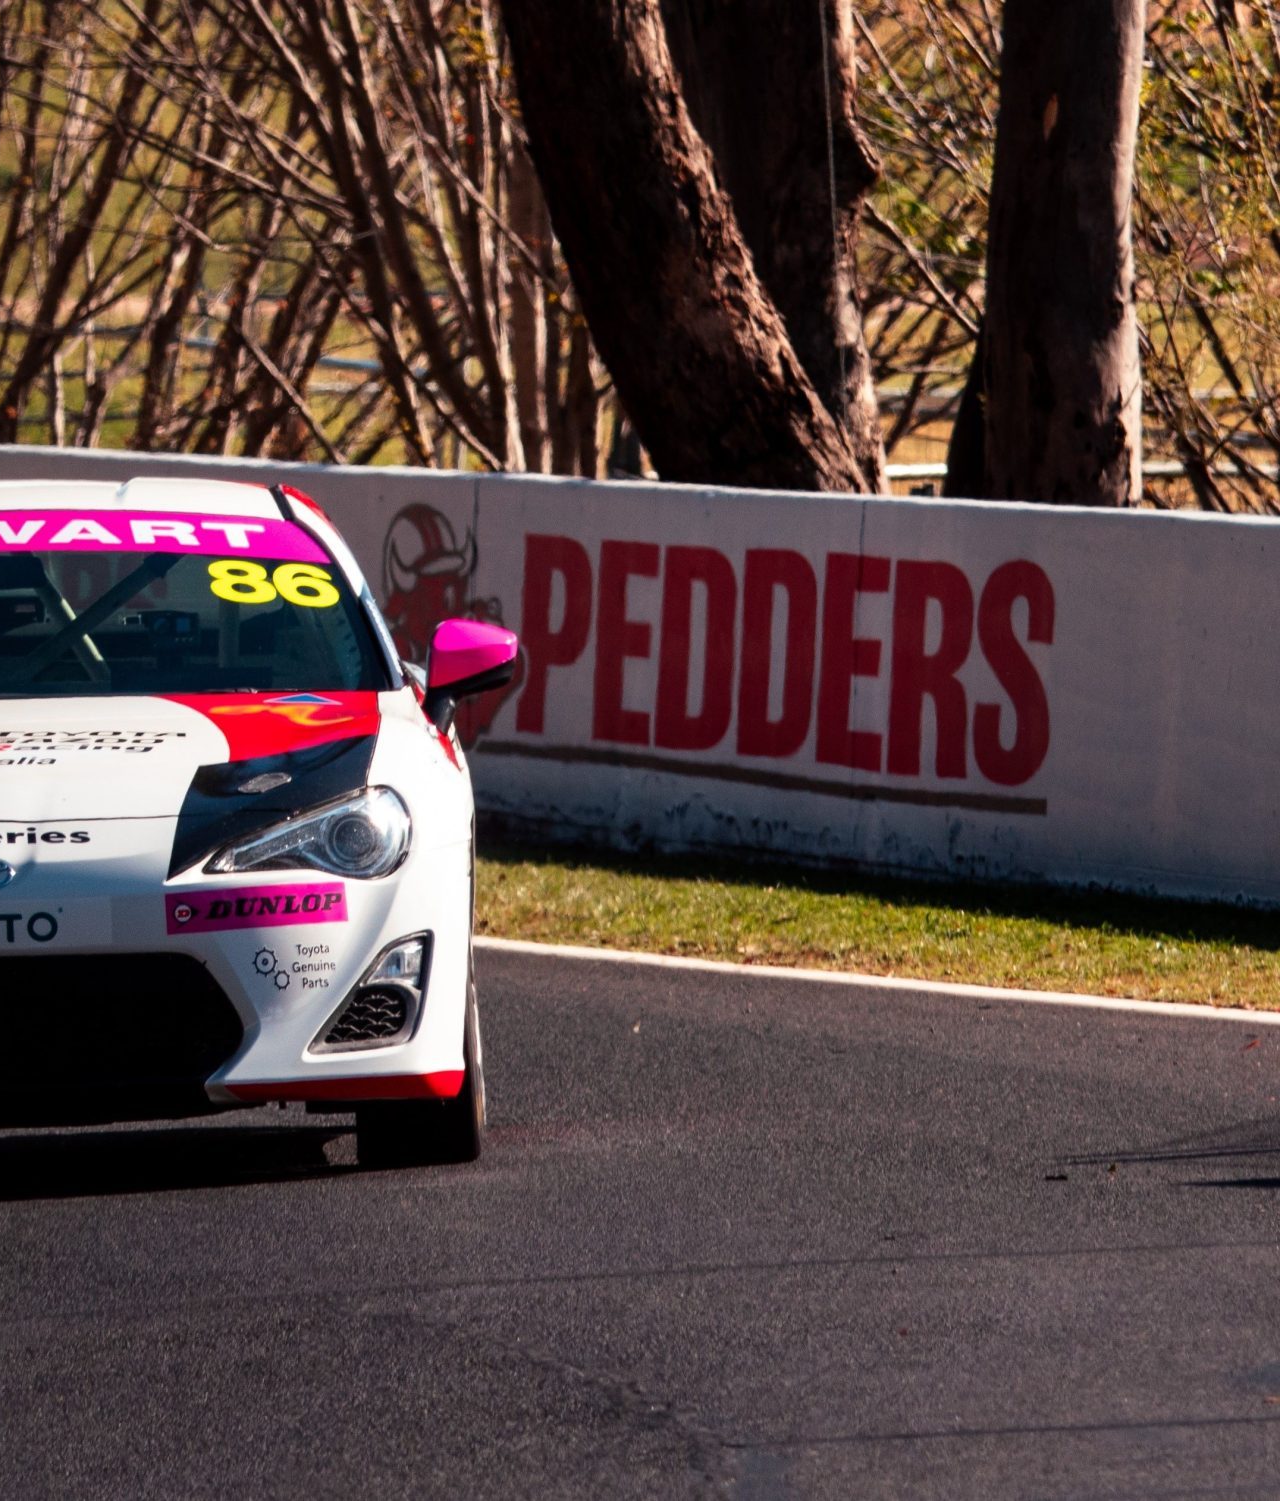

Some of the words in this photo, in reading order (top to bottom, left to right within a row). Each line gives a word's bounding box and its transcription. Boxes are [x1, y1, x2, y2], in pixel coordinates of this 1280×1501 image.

[207, 559, 340, 608] 86
[516, 533, 1055, 786] PEDDERS
[205, 893, 342, 920] DUNLOP
[295, 943, 330, 958] Toyota
[291, 960, 336, 973] Genuine
[302, 976, 330, 989] Parts
